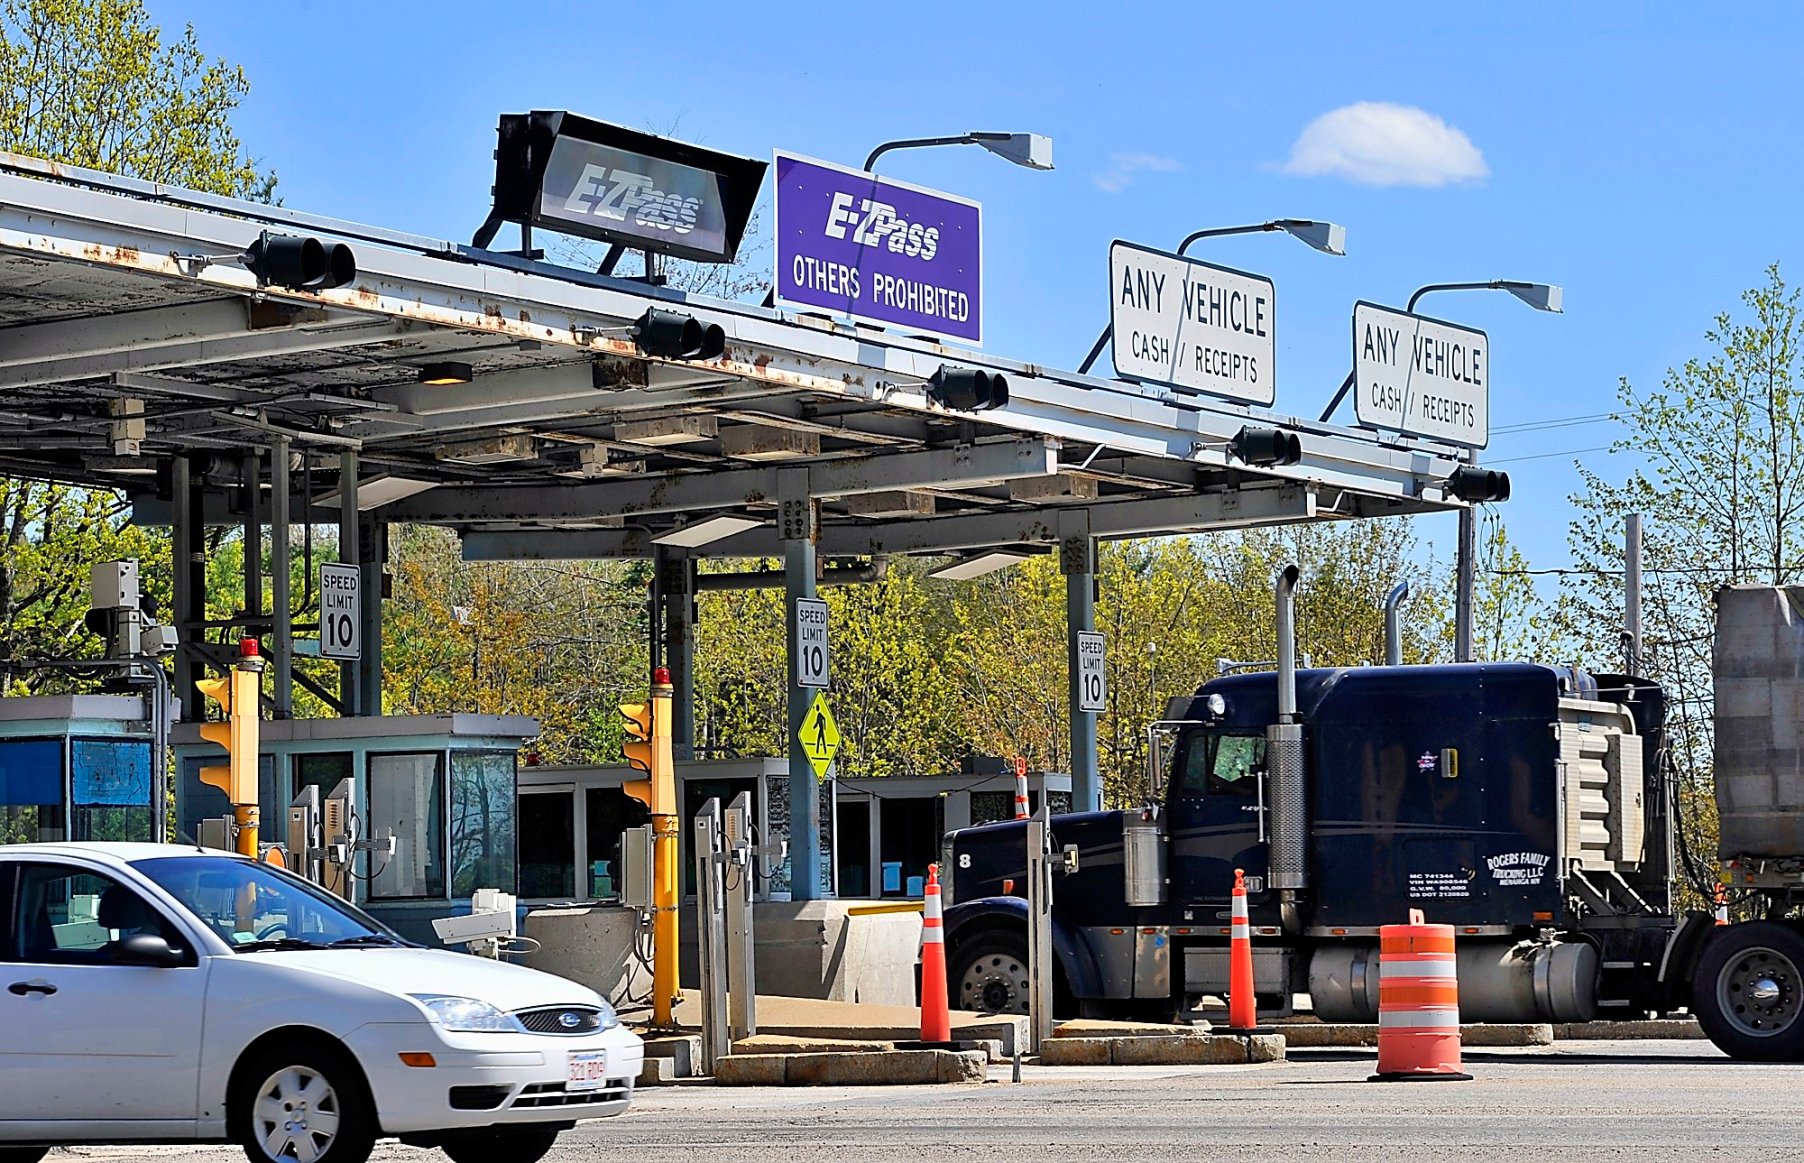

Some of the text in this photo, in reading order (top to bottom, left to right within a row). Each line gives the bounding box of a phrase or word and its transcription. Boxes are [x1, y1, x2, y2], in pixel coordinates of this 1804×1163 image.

[564, 163, 699, 234] E-ZPass
[824, 191, 939, 261] E-ZPass
[793, 254, 969, 322] OTHERS PROHIBITED
[1121, 264, 1267, 338] ANY VEHICLE
[1132, 330, 1169, 365] CASH
[1195, 345, 1258, 383] RECEIPTS
[1363, 323, 1482, 386] ANY VEHICLE
[1372, 382, 1402, 413] CASH
[1424, 393, 1474, 428] RECEIPTS
[323, 574, 357, 591] SPEED
[327, 593, 353, 610] LIMIT
[328, 613, 353, 648] 10
[800, 609, 826, 624] SPEED
[802, 627, 823, 642] LIMIT
[1081, 641, 1103, 654] SPEED
[803, 645, 823, 677] 10
[1083, 657, 1101, 670] LIMIT
[1084, 673, 1101, 702] 10
[959, 853, 971, 868] 8
[1487, 852, 1551, 870] ROGERS FAMILY
[1527, 866, 1544, 878] LLC
